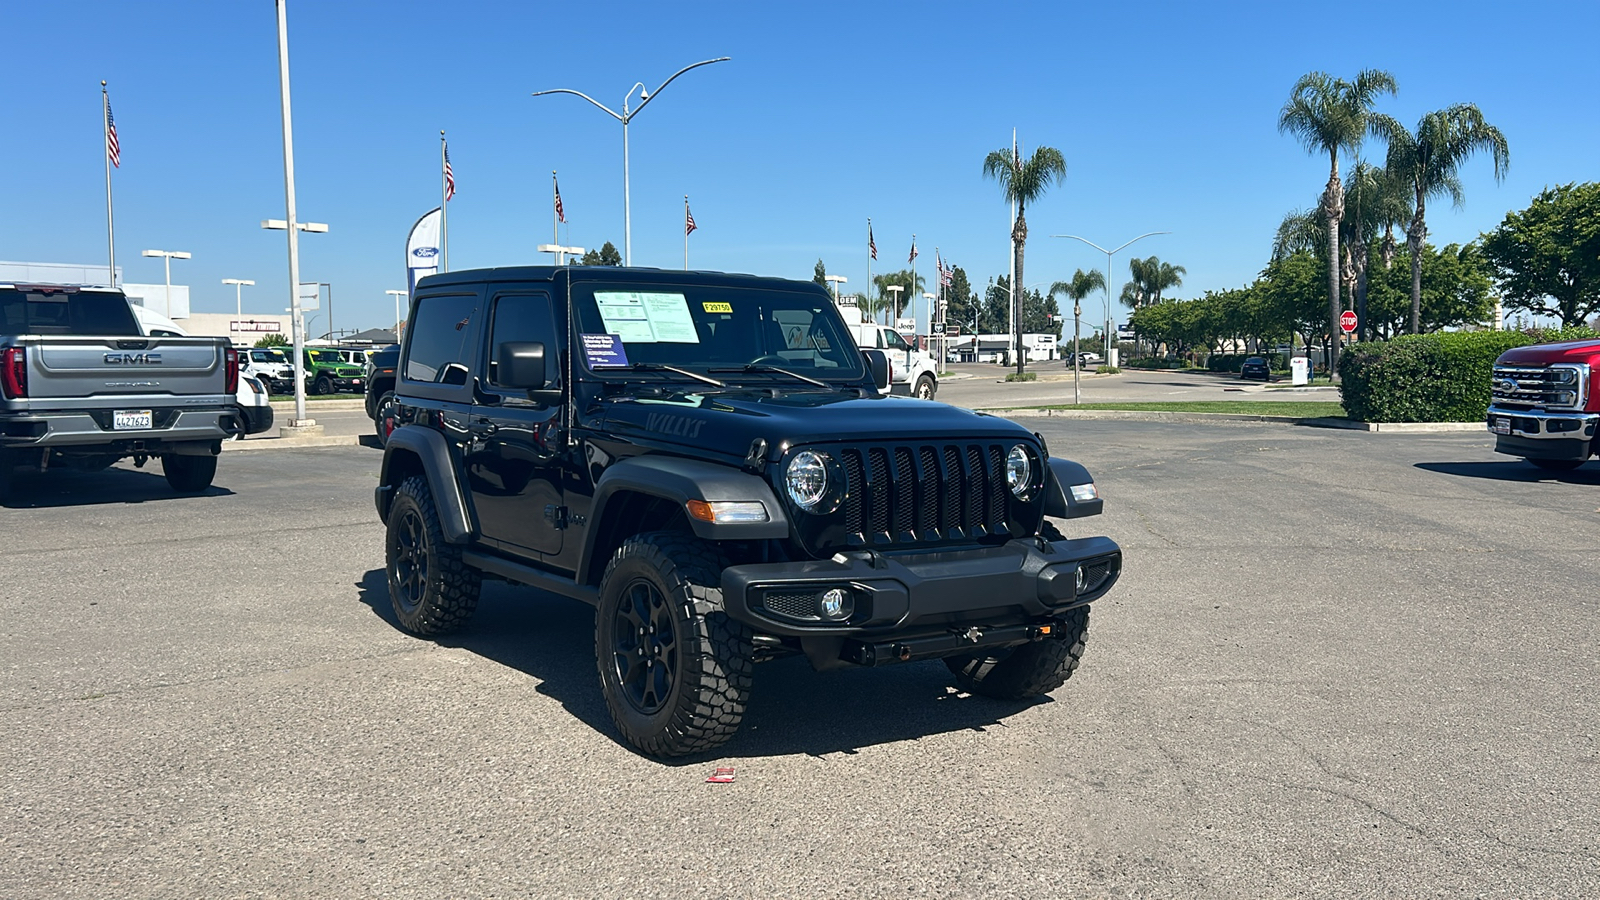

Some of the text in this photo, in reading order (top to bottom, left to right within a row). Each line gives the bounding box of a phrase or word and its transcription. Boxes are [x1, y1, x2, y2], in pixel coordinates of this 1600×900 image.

[417, 248, 434, 257] Ford
[1341, 317, 1356, 326] STOP
[231, 323, 256, 331] WNDOW
[898, 323, 915, 331] Jeep
[103, 353, 162, 364] GMC
[646, 412, 707, 438] WILLYS
